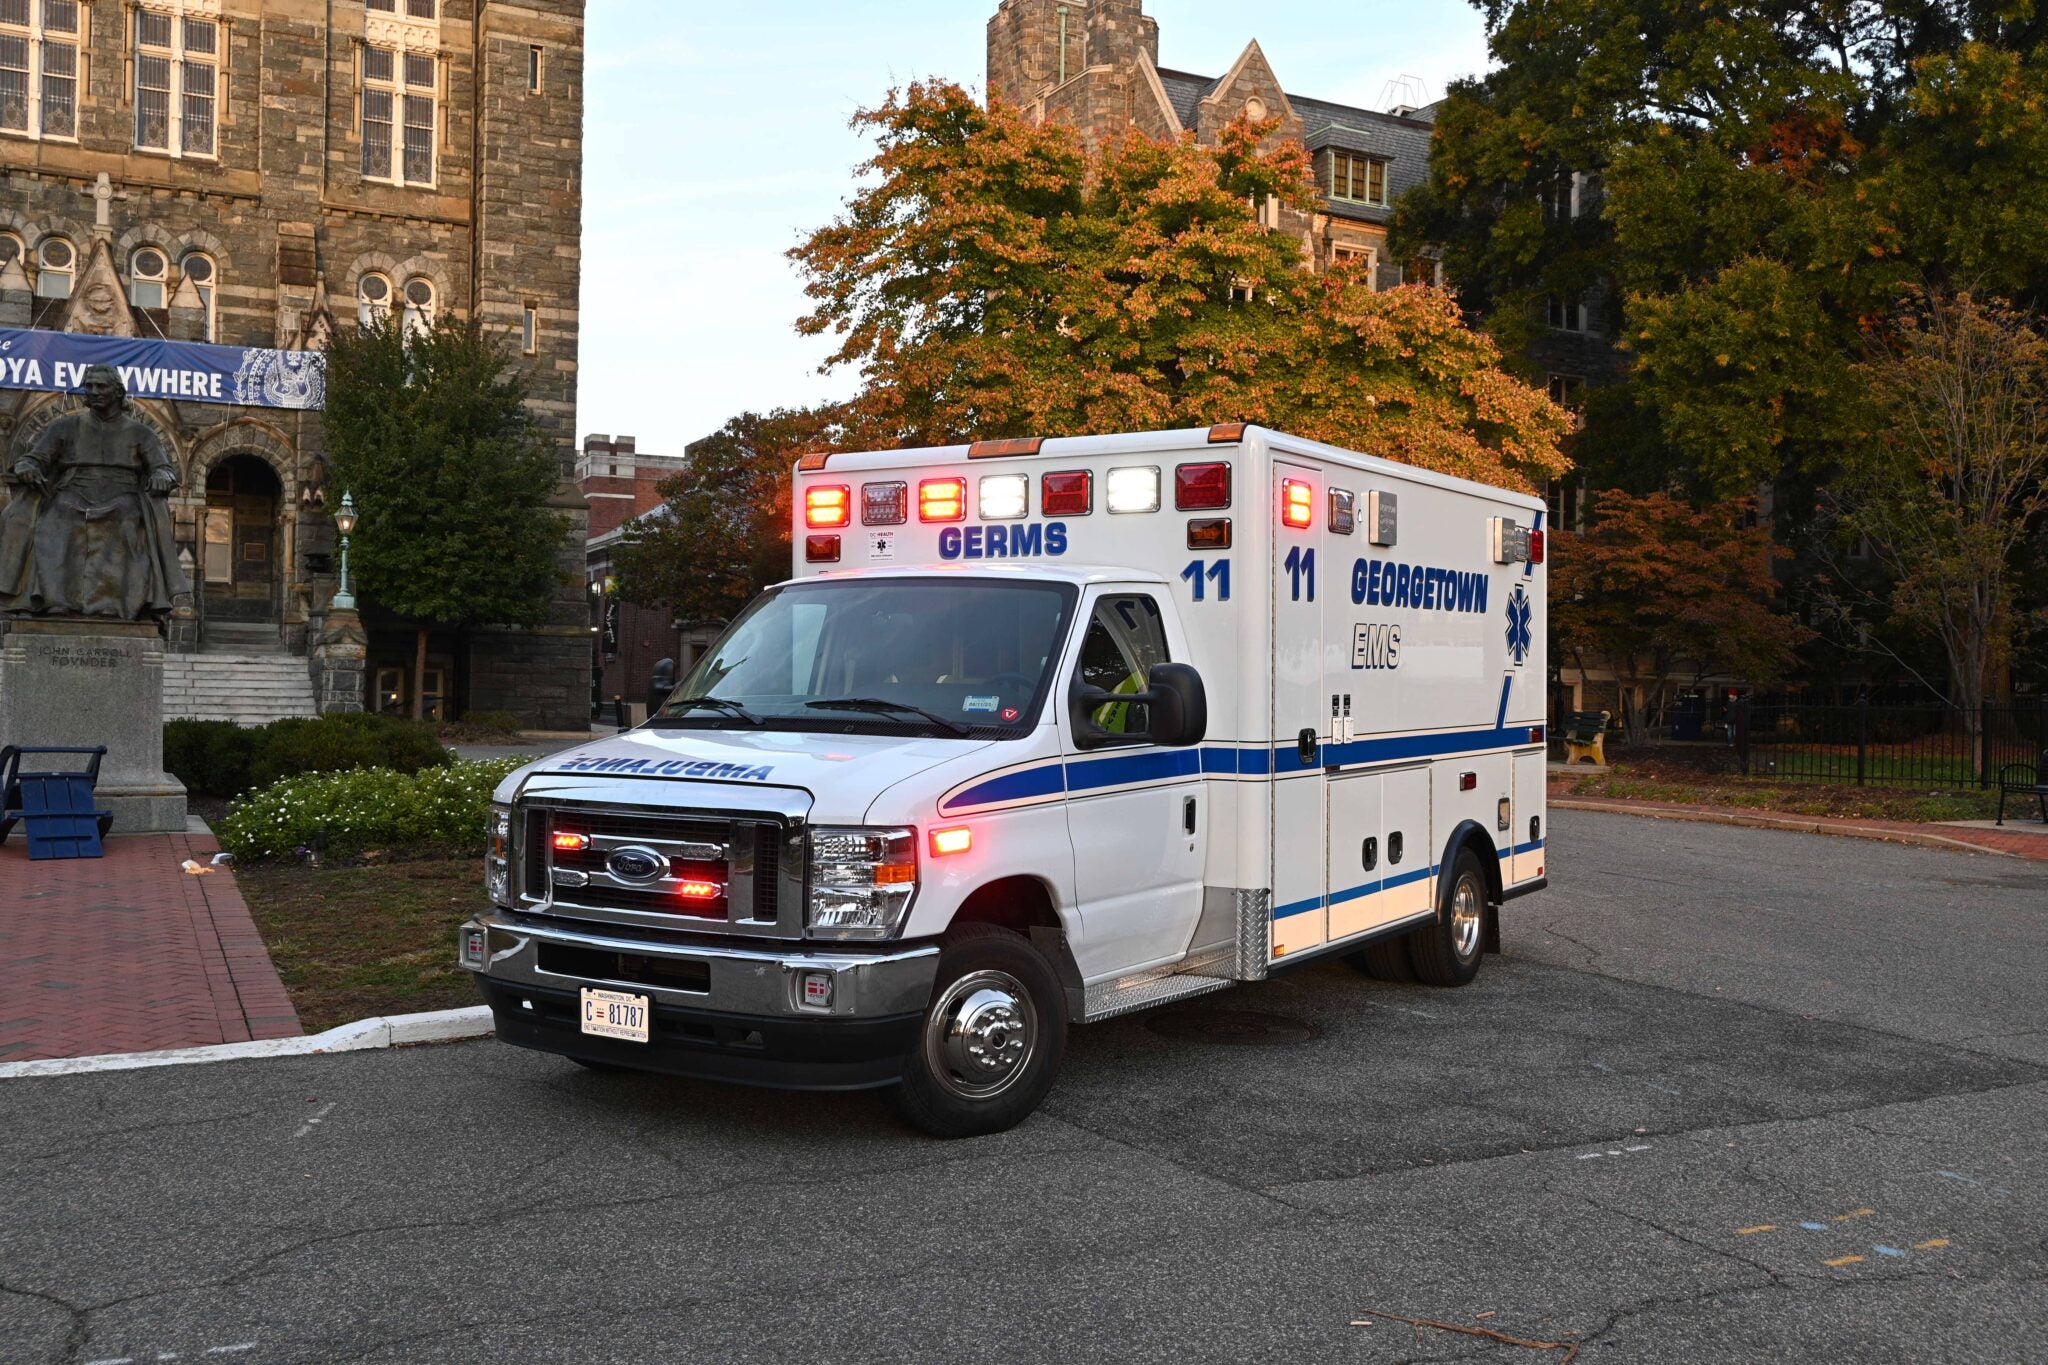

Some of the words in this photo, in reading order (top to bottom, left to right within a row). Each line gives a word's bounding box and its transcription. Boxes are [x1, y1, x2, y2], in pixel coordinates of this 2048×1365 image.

[54, 361, 222, 398] EVYWHERE
[938, 521, 1068, 560] GERMS
[1180, 558, 1231, 602] 11
[1284, 545, 1315, 602] 11
[1351, 557, 1489, 614] GEORGETOWN
[38, 646, 70, 656] JOHN
[76, 647, 133, 658] CARROLL
[1351, 622, 1402, 669] EMS
[617, 855, 645, 872] Ford
[586, 1000, 592, 1021] C
[609, 1003, 644, 1028] 81787
